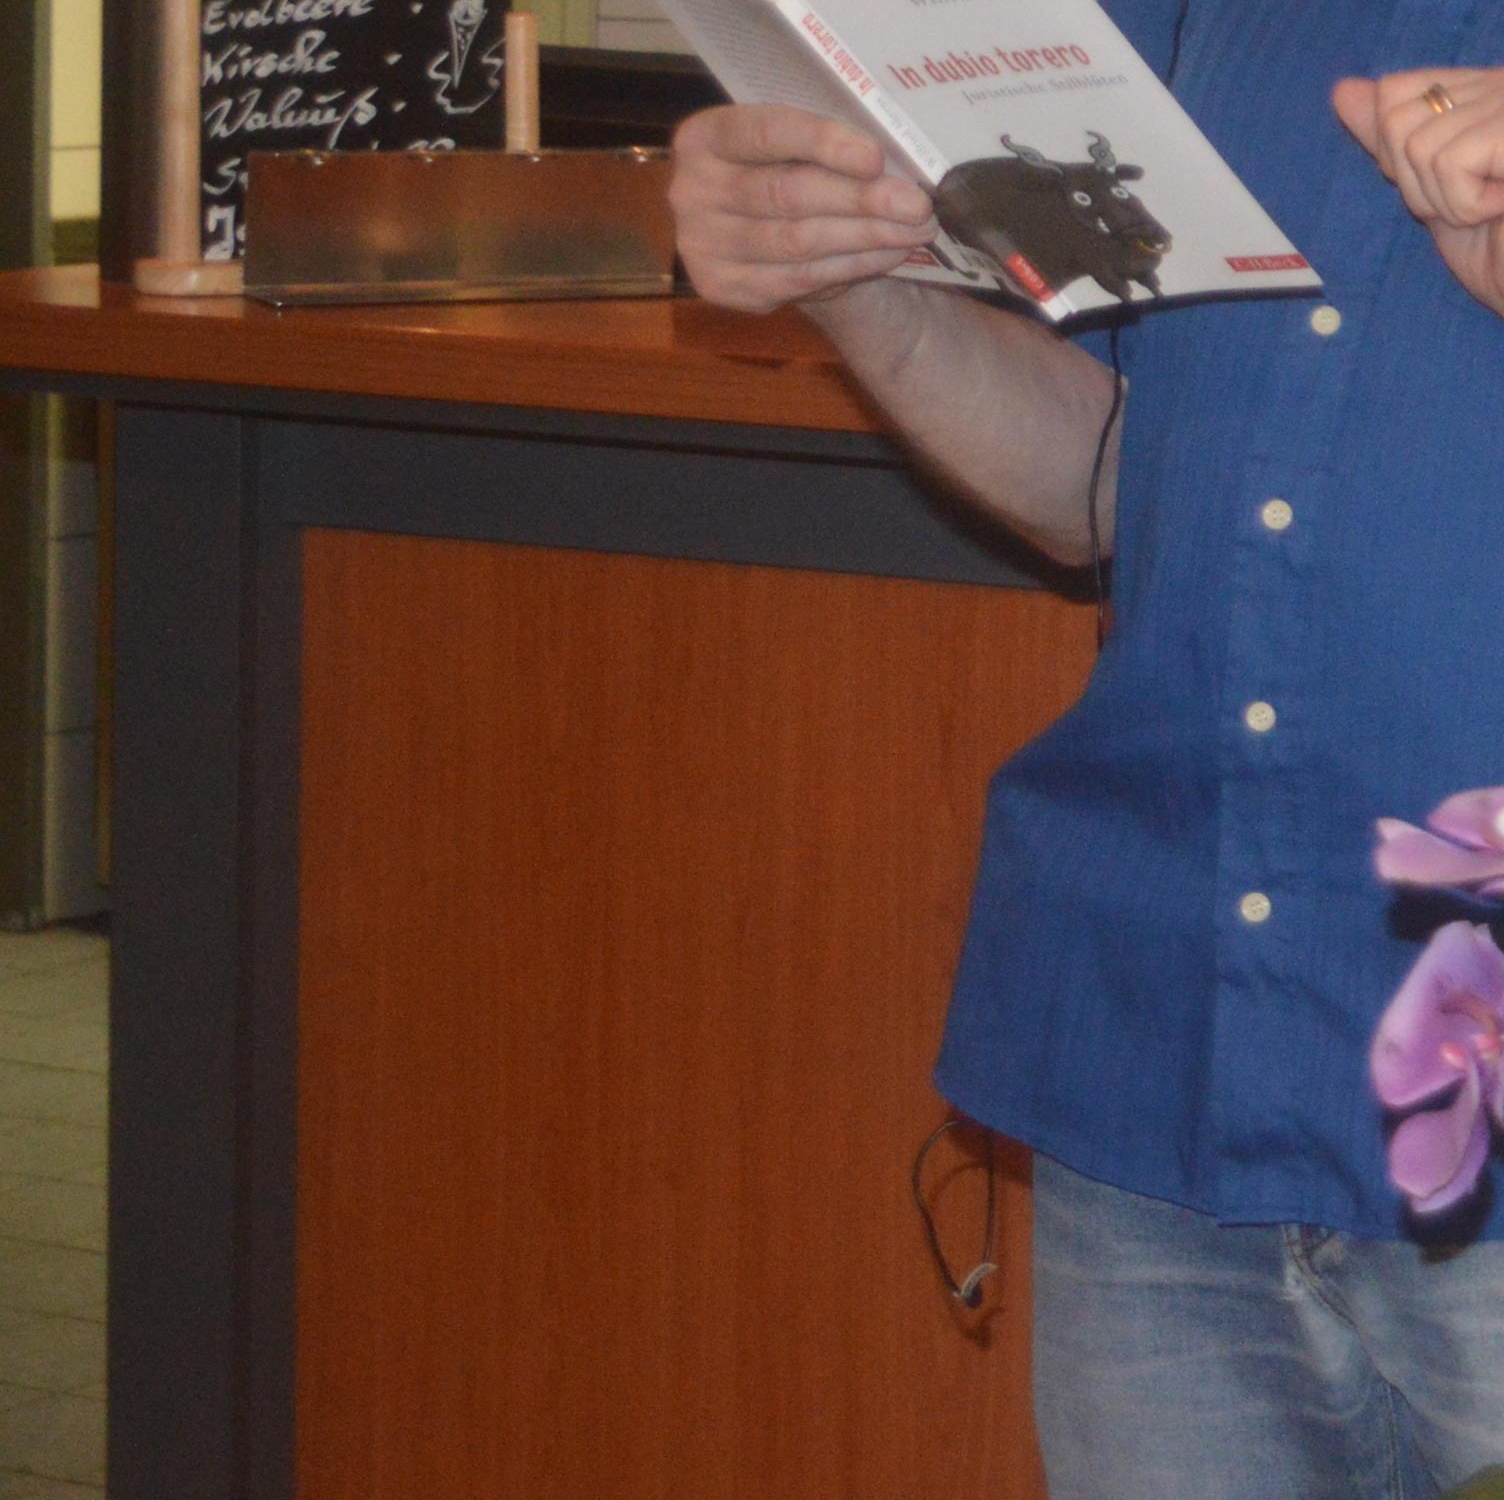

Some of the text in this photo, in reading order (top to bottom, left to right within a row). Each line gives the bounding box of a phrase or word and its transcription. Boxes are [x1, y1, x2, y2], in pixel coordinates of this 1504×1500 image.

[200, 29, 341, 86] Kirsche
[887, 42, 1092, 90] In dubio torero
[961, 72, 1129, 106] Juristische Stilblüten
